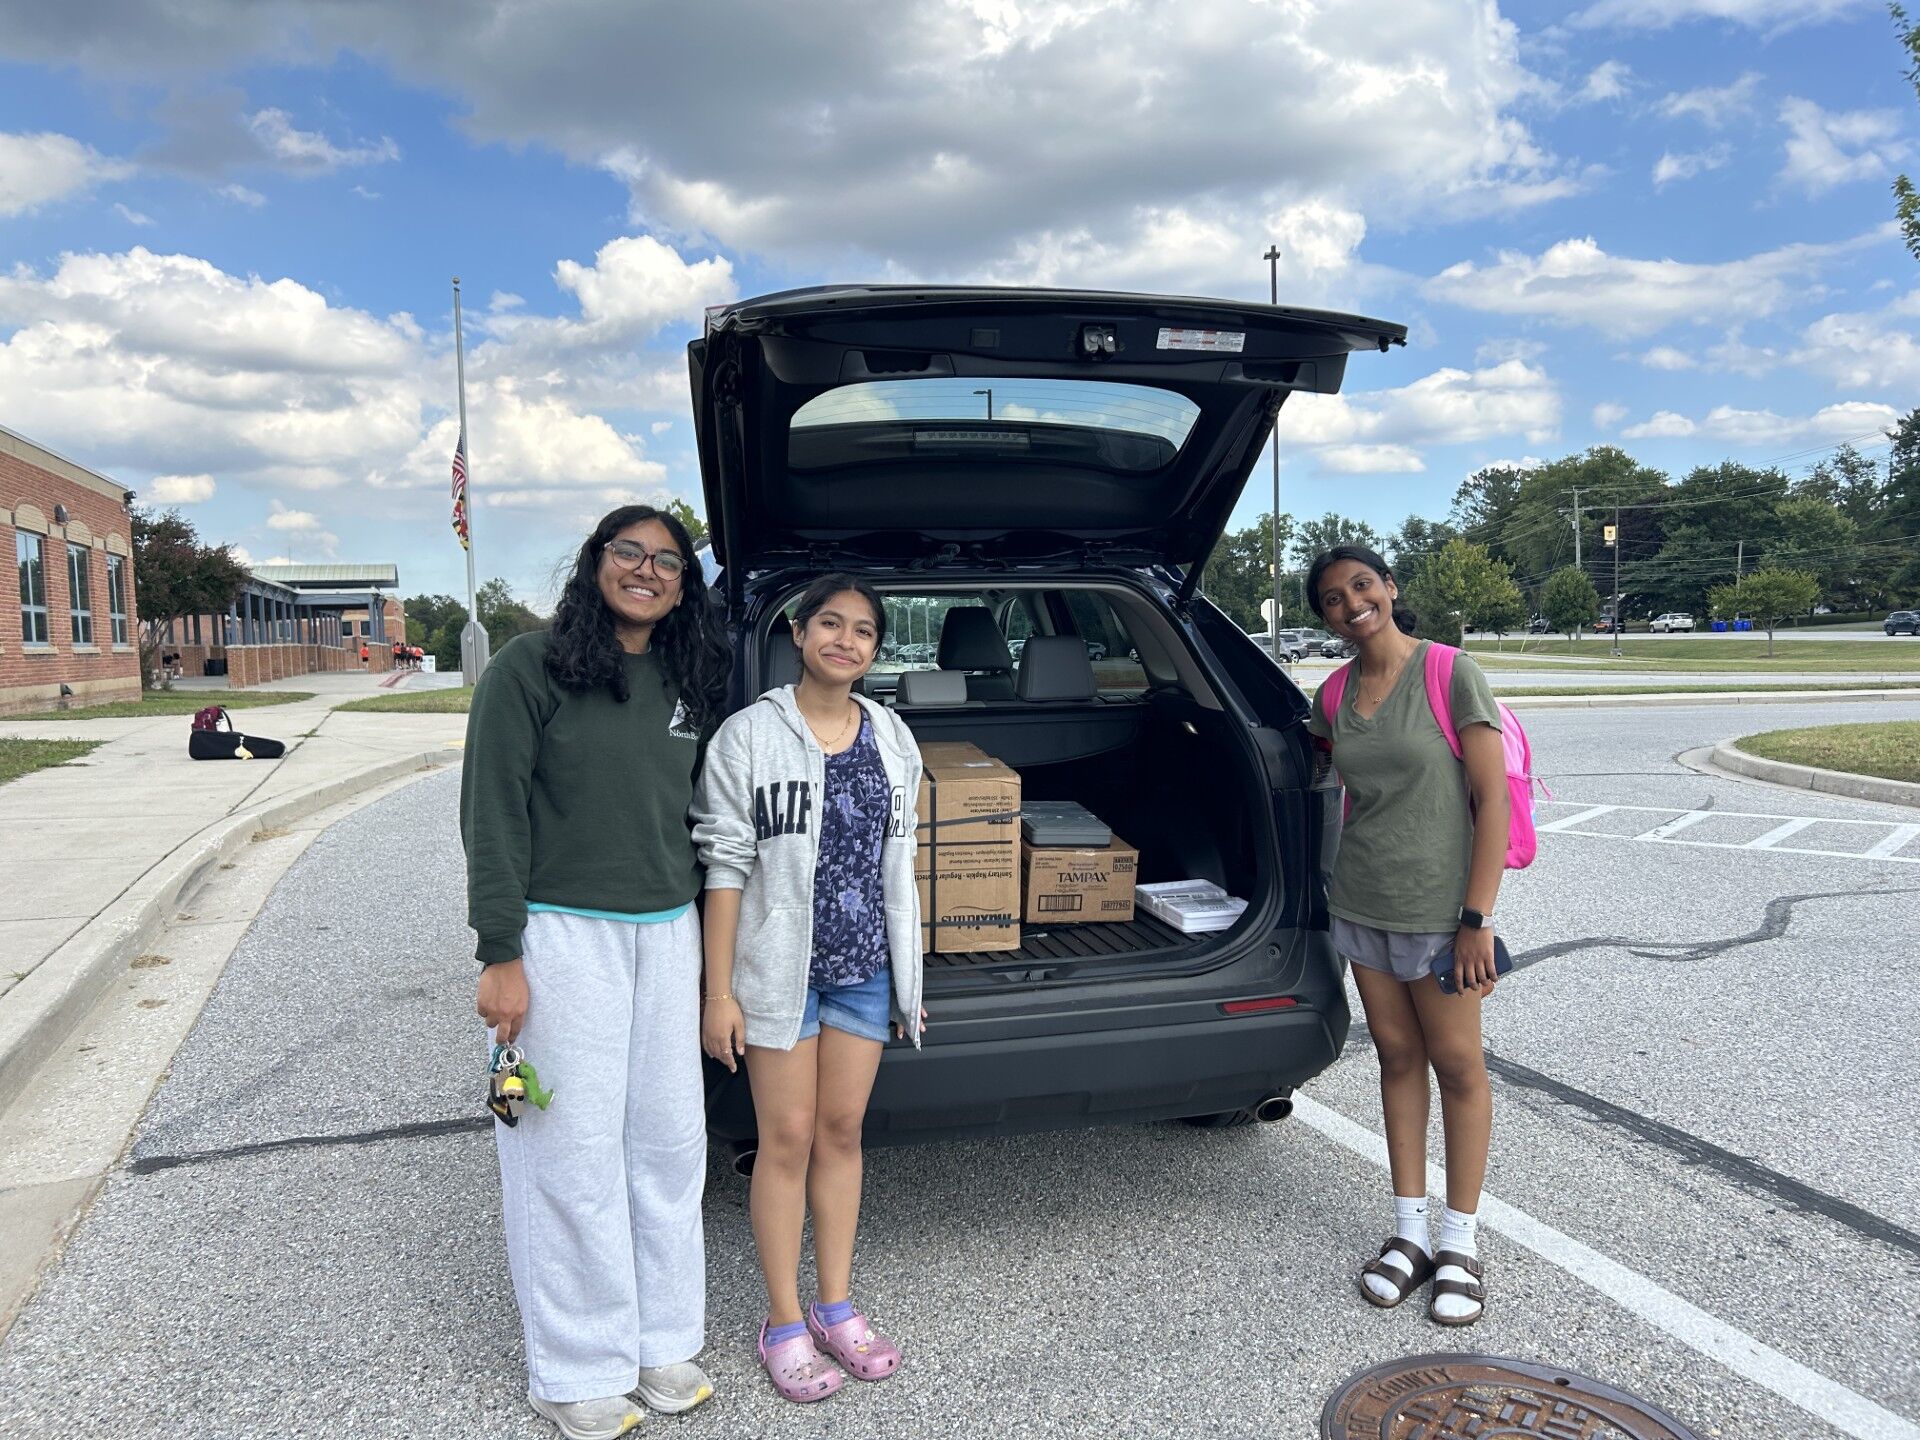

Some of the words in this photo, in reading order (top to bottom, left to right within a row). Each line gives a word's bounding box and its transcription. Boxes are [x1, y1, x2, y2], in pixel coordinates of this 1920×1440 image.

[939, 872, 962, 880] Regular
[966, 872, 985, 880] Napkin
[986, 871, 1012, 879] Sanitary
[1057, 872, 1108, 883] TAMPAX
